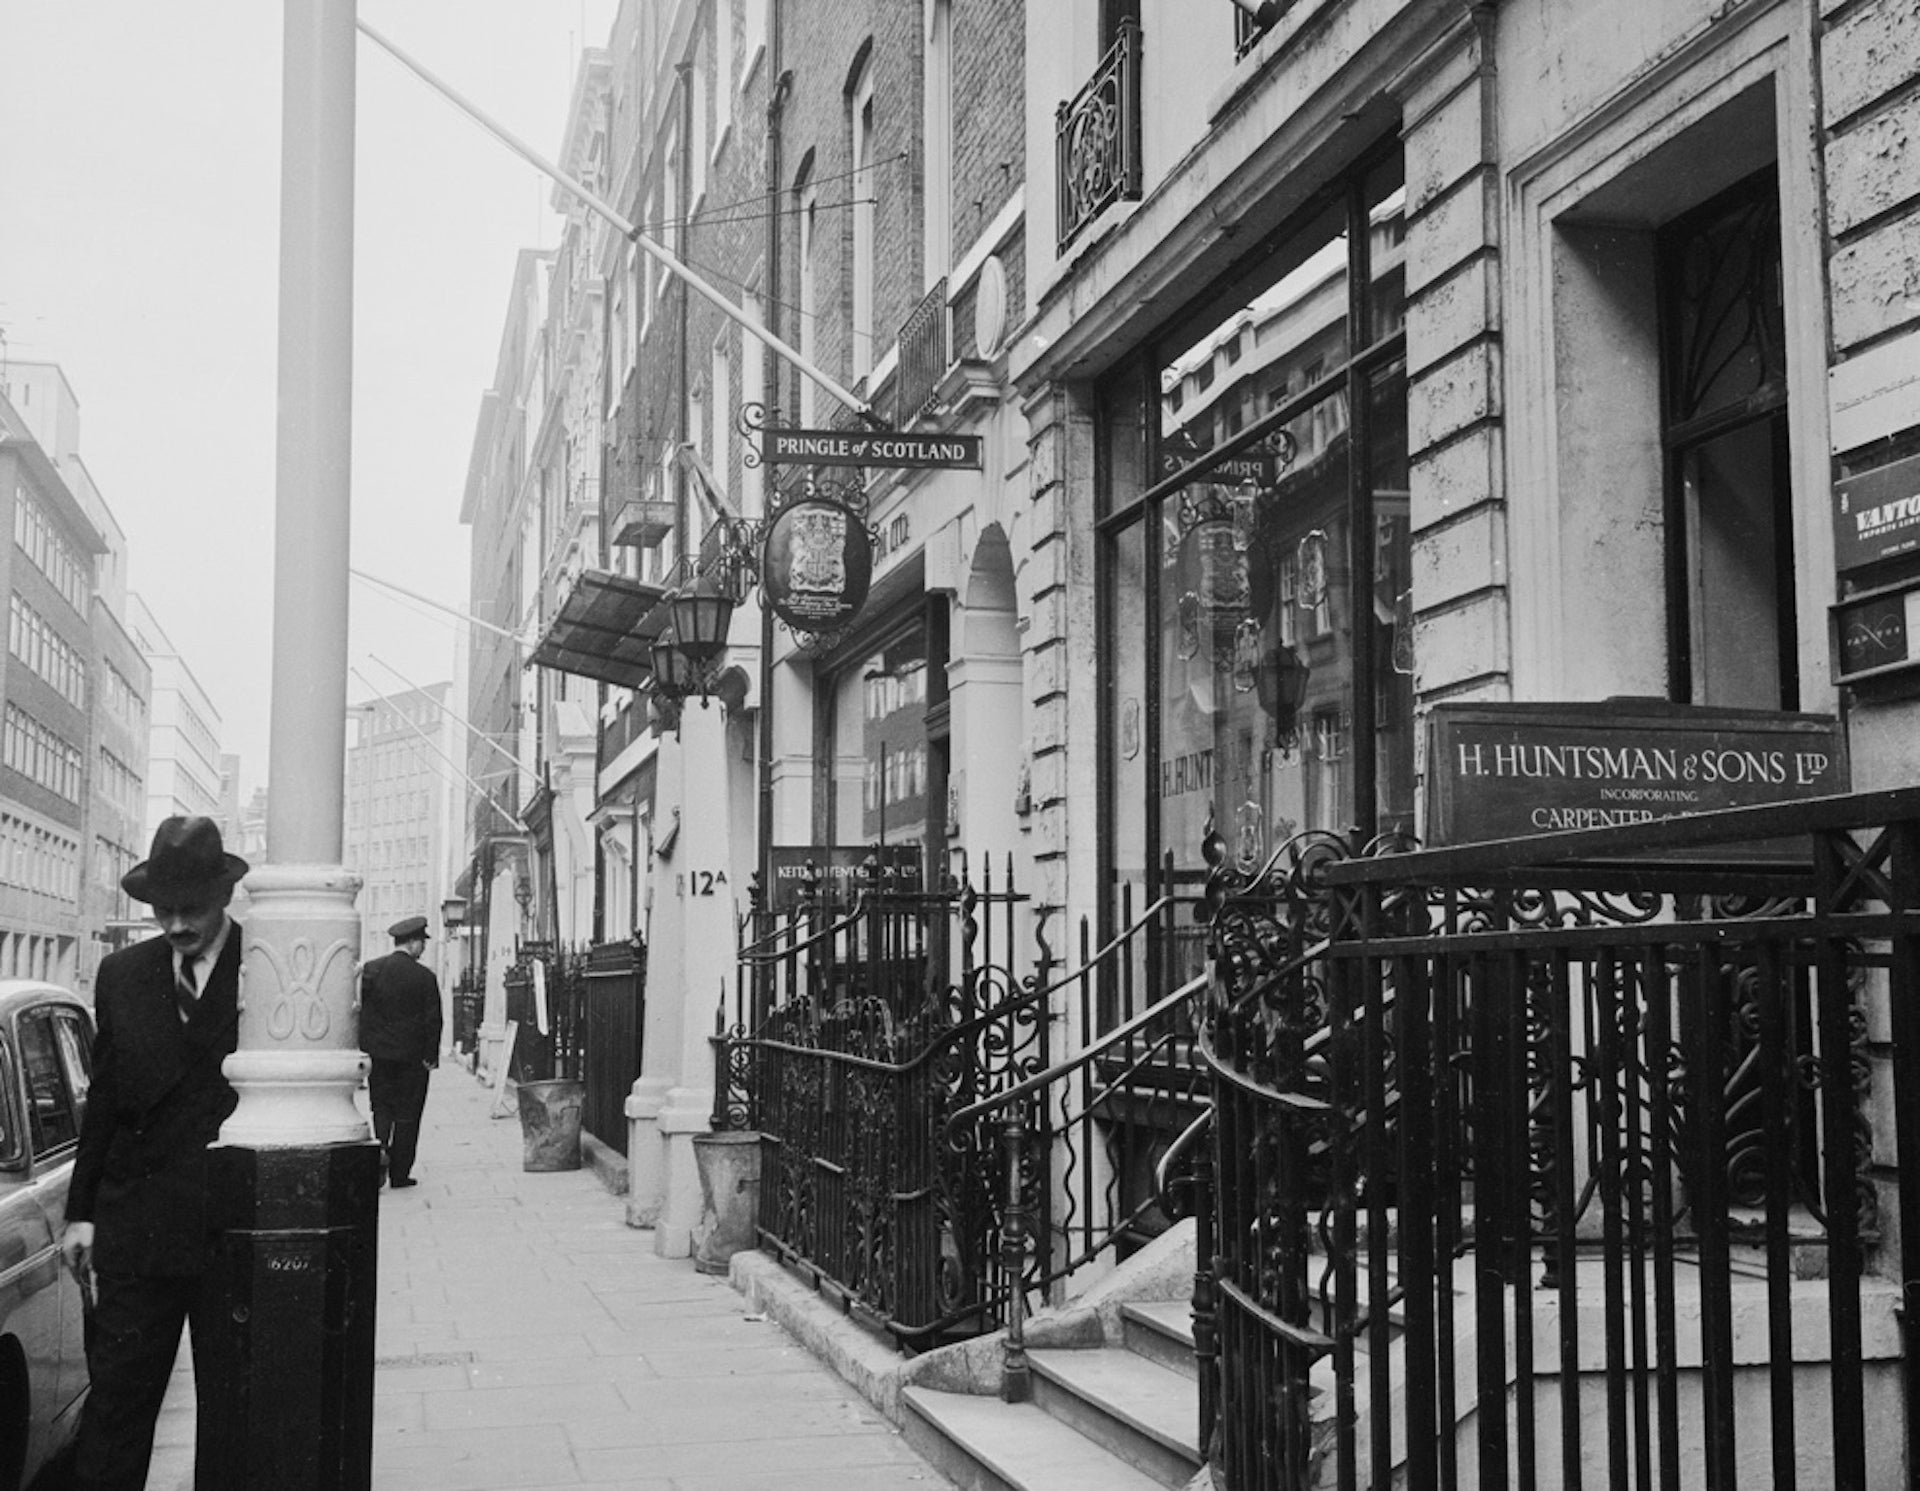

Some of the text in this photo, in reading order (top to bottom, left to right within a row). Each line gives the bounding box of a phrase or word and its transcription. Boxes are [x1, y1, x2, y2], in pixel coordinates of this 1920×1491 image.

[776, 436, 966, 461] PRINGLE of SCOTLAND
[1458, 743, 1830, 785] H. HUNTSMAN & SONS LTD
[1600, 788, 1700, 803] INCORPORATING
[691, 869, 728, 897] 12A
